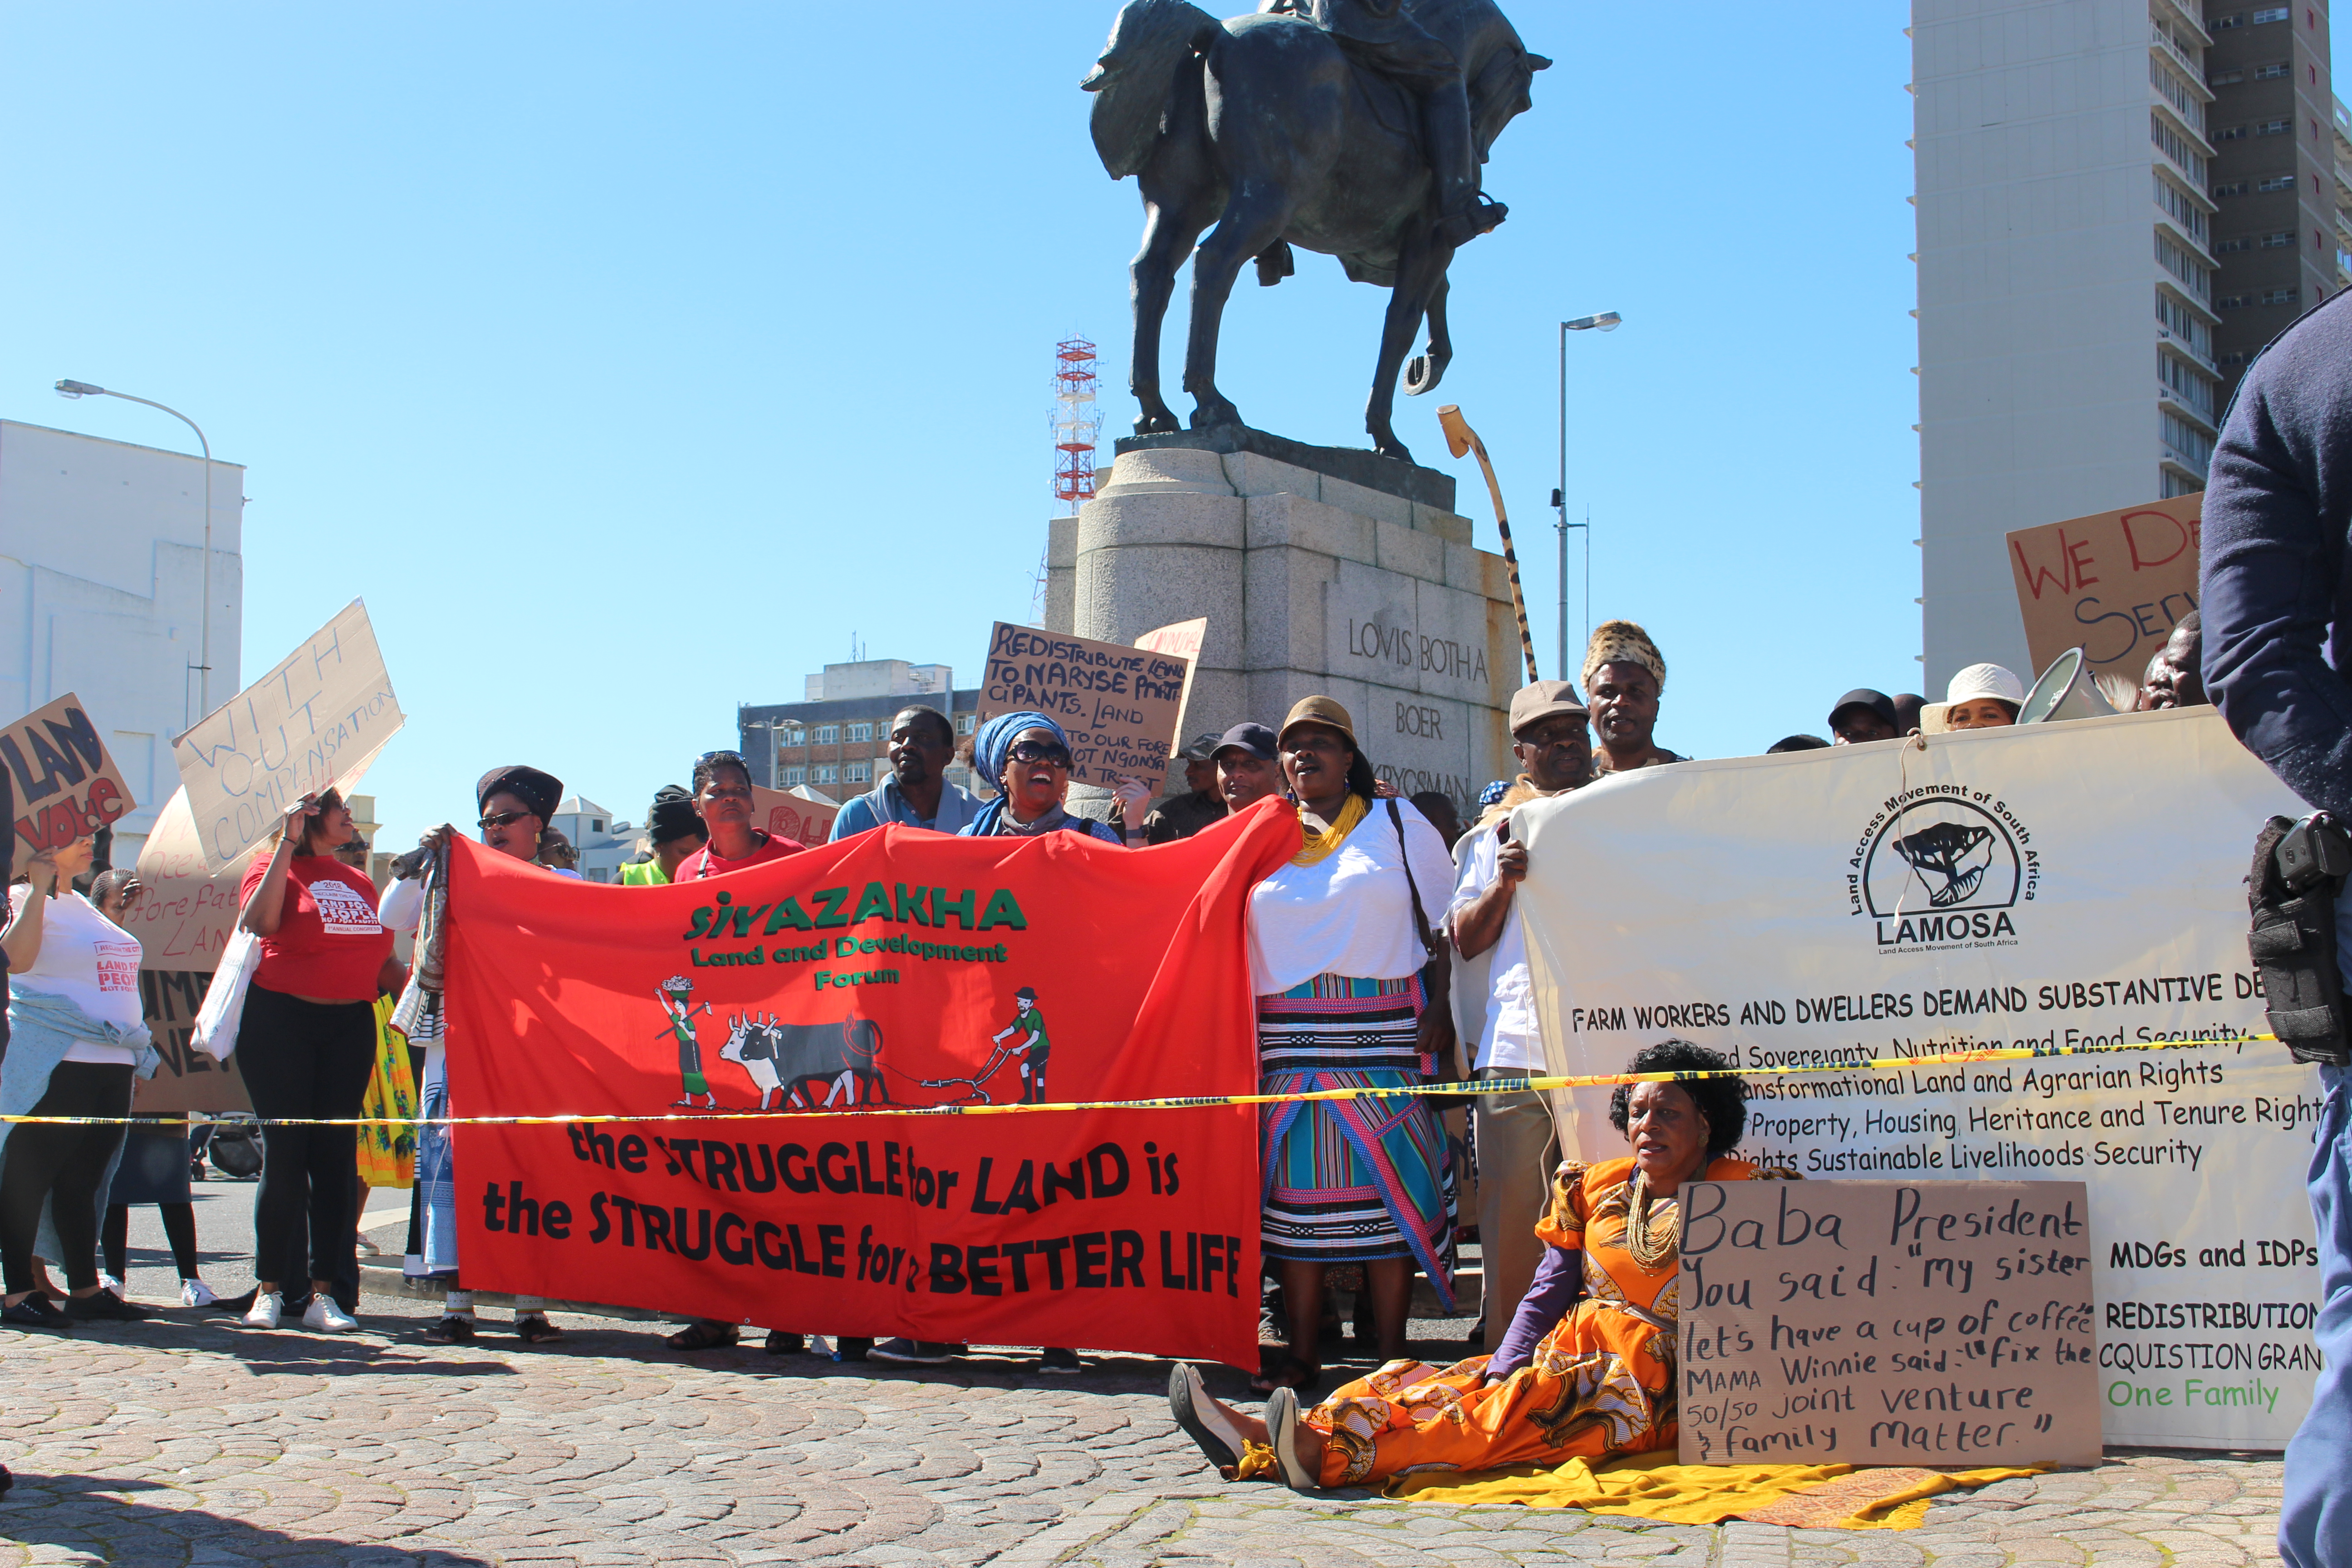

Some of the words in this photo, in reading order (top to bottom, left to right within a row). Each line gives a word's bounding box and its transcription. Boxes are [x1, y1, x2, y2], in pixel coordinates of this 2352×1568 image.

[2014, 528, 2100, 600] WE
[2120, 510, 2201, 572] DE
[990, 624, 1145, 672] REDISTRIBUTE
[1147, 658, 1186, 680] LAND
[1420, 635, 1488, 684] BOTHA
[186, 627, 342, 768] WITH
[1091, 698, 1144, 730] LAND
[1396, 702, 1443, 740] BOER
[221, 690, 323, 797] OUT
[1065, 729, 1091, 743] TO
[1094, 734, 1133, 749] OUR
[1138, 738, 1171, 755] FORE
[215, 682, 395, 861] COMPENSATION
[1093, 768, 1161, 791] TRST
[1883, 784, 1968, 812] Movement
[1973, 791, 1992, 804] of
[1849, 811, 1885, 869] Access
[1993, 801, 2031, 845] South
[323, 882, 342, 890] 2018
[2024, 849, 2041, 901] Africa
[131, 883, 238, 922] forefat
[314, 899, 346, 908] LAND
[348, 901, 370, 909] FOR
[318, 906, 378, 920] PEOPLE
[1847, 873, 1863, 916] Land
[162, 920, 232, 956] LAN
[1876, 911, 2016, 945] LAMOSA
[1898, 945, 1924, 954] Access
[1926, 943, 1963, 952] Movement
[1974, 940, 1995, 948] South
[1996, 938, 2018, 946] Africa
[97, 960, 127, 971] LAND
[129, 961, 139, 971] FO
[691, 944, 764, 968] Land
[772, 938, 828, 965] and
[834, 932, 1009, 964] Development
[98, 973, 137, 986] PEOP
[815, 968, 900, 990] Forum
[1572, 1007, 1627, 1033] FARM
[1633, 1002, 1730, 1030] WORKERS
[1740, 1003, 1786, 1025] AND
[1796, 992, 1914, 1023] DWELLERS
[1924, 987, 2027, 1017] DEMAND
[2038, 973, 2223, 1011] SUBSTANTIVE
[2234, 972, 2266, 999] DE
[1893, 1032, 2002, 1058] Nutrition
[2014, 1029, 2054, 1054] and
[2065, 1025, 2124, 1055] Food
[2136, 1022, 2248, 1055] Security
[1746, 1071, 1904, 1101] ansformational
[1912, 1069, 1966, 1094] Land
[1973, 1068, 2013, 1093] and
[2023, 1064, 2132, 1099] Agrarian
[2139, 1060, 2223, 1093] Rights
[1752, 1112, 1857, 1143] Property,
[1969, 1106, 2092, 1133] Heritance
[2100, 1101, 2145, 1128] and
[2153, 1100, 2247, 1125] Tenure
[2255, 1095, 2322, 1131] Right
[567, 1123, 648, 1174] the
[906, 1146, 959, 1210] for
[970, 1142, 1130, 1215] LAND
[1143, 1141, 1179, 1196] is
[1806, 1143, 1944, 1172] Sustainable
[1951, 1140, 2084, 1169] Livelihoods
[2094, 1139, 2202, 1172] Security
[1679, 1183, 1849, 1256] Baba
[1890, 1187, 2082, 1246] President
[483, 1181, 573, 1240] the
[589, 1191, 846, 1279] STRUGGLE
[858, 1224, 906, 1286] for
[929, 1229, 1146, 1297] BETTER
[1160, 1230, 1241, 1299] LIFE
[2110, 1241, 2186, 1269] MDGs
[2199, 1239, 2246, 1267] and
[2256, 1239, 2319, 1267] IDPs
[1682, 1256, 1754, 1311] You
[1995, 1247, 2090, 1281] sister
[1686, 1321, 1754, 1362] let's
[1771, 1314, 1841, 1351] have
[1856, 1321, 1878, 1340] a
[1893, 1317, 1945, 1344] cup
[1958, 1298, 1999, 1335] of
[1686, 1368, 1761, 1397] MAMA
[1780, 1351, 1877, 1386] Winnie
[2055, 1337, 2091, 1365] the
[2099, 1343, 2251, 1375] CQUISTION
[2258, 1343, 2322, 1371] GRAN
[1687, 1397, 1758, 1431] 50/50
[1772, 1385, 1856, 1419] joint
[1880, 1382, 2033, 1414] venture
[2107, 1380, 2173, 1406] One
[2185, 1377, 2279, 1414] Family
[1726, 1424, 1837, 1458] family
